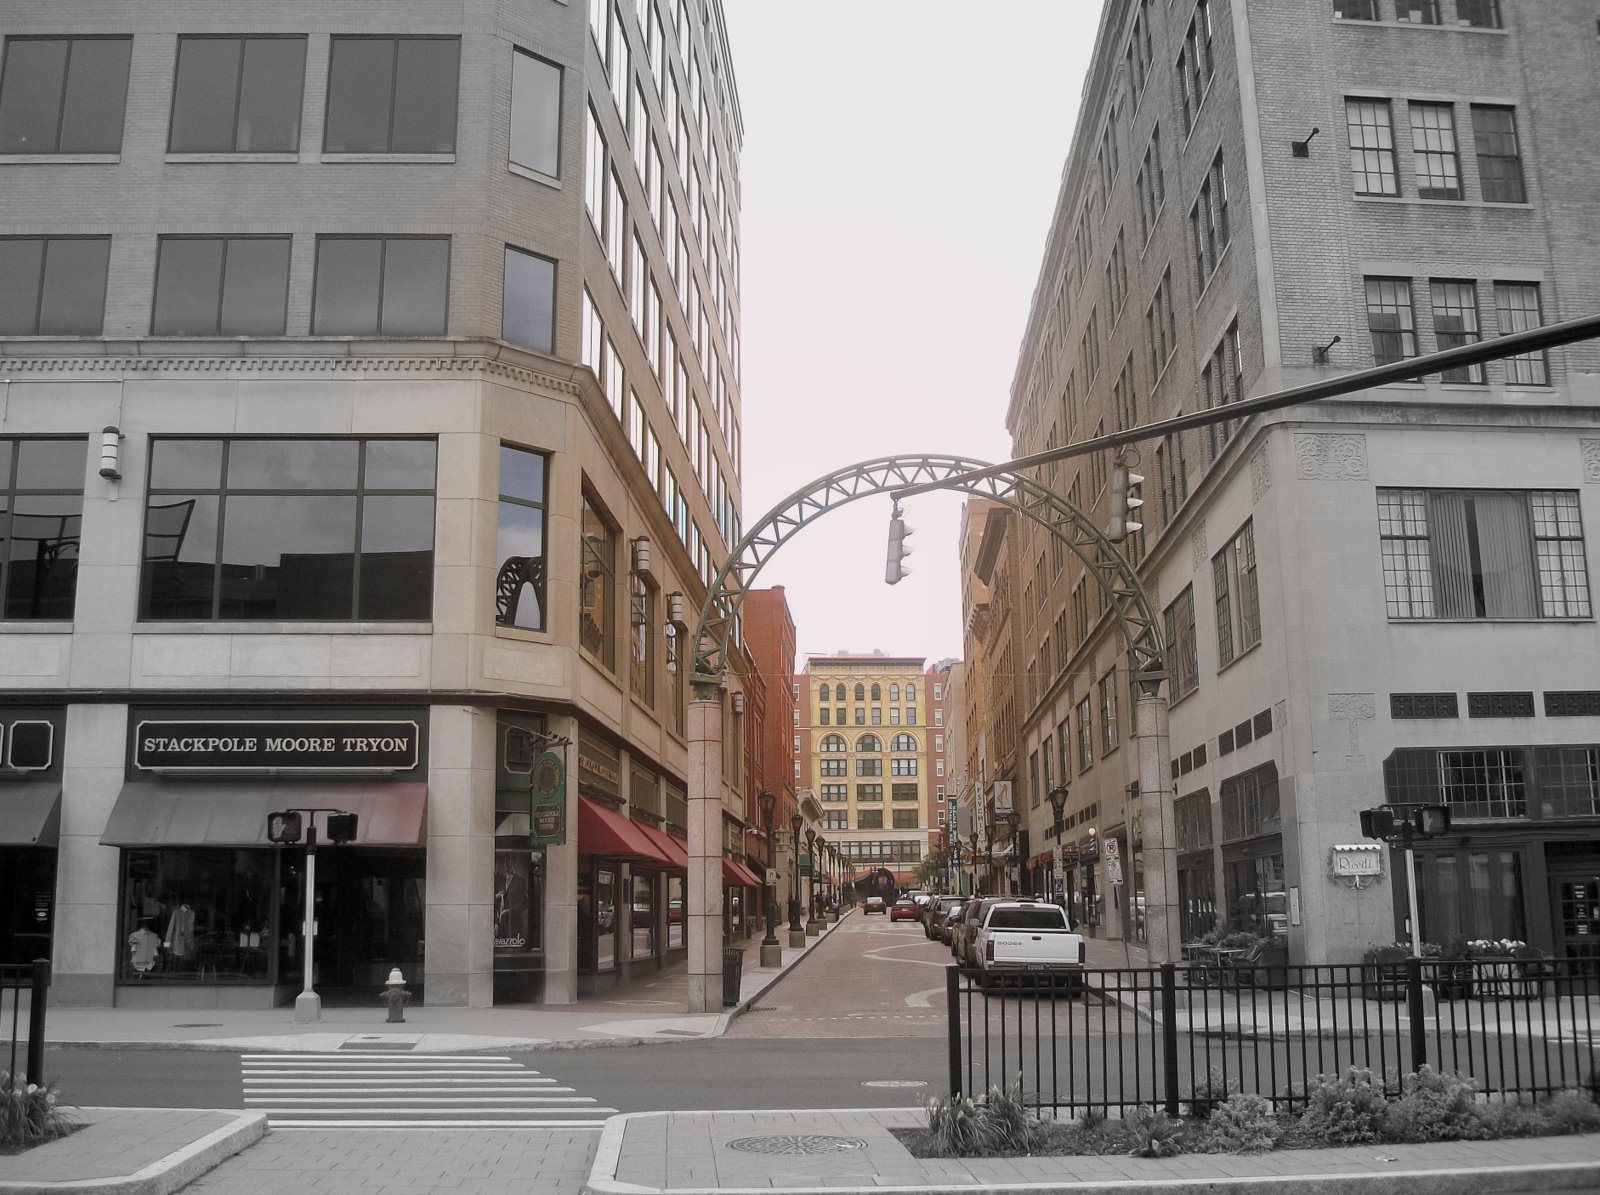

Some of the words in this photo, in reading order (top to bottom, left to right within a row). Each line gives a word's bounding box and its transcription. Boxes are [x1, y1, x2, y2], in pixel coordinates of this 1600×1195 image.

[144, 737, 257, 752] STACKPOLE
[265, 737, 336, 752] MOORE
[343, 737, 409, 752] TRYON
[976, 786, 984, 836] PSYCHIC
[494, 933, 526, 945] avazzolo
